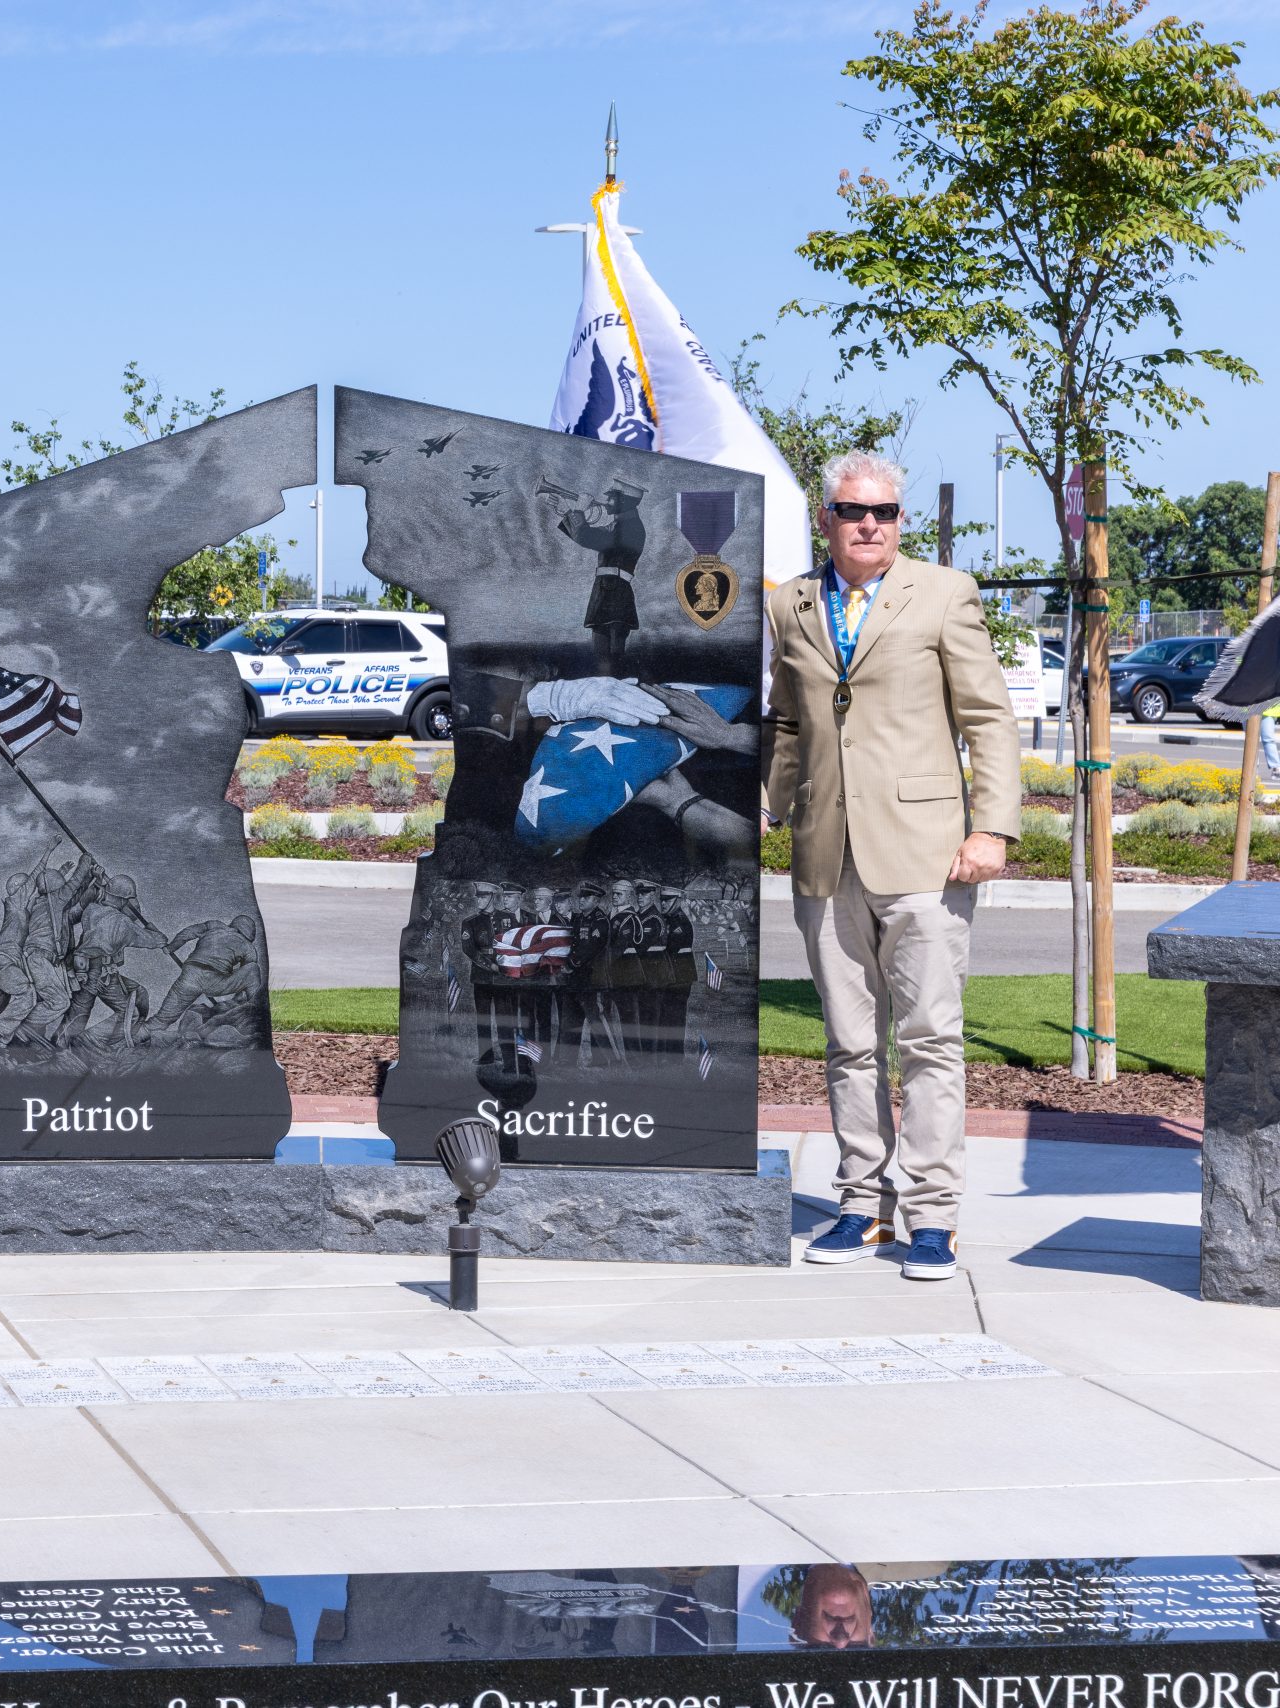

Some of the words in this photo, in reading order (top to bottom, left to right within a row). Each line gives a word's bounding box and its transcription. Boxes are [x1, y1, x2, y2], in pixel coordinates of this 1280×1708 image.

[1066, 486, 1084, 516] STO
[289, 666, 333, 675] VETERANS
[283, 674, 407, 696] POLICE
[282, 697, 292, 706] To
[295, 697, 325, 706] Protect
[328, 696, 349, 705] Those
[352, 695, 370, 703] Who
[373, 694, 402, 703] Served
[22, 1096, 154, 1133] Patriot
[477, 1099, 655, 1139] Sacrifice
[968, 1576, 1076, 1588] Veteran
[1075, 1573, 1232, 1585] Hernandez,
[867, 1580, 966, 1590] USMC
[17, 1588, 104, 1598] Green
[112, 1587, 180, 1595] Gina
[993, 1589, 1081, 1599] USAF
[1081, 1586, 1190, 1596] Veteran
[0, 1599, 102, 1609] Adame
[104, 1597, 190, 1607] Mary
[976, 1600, 1077, 1610] USMC
[1081, 1597, 1189, 1608] Veteran
[0, 1611, 101, 1621] Graves
[109, 1609, 198, 1619] Kevin
[930, 1612, 1032, 1623] USMC
[1033, 1610, 1143, 1621] Veteran
[22, 1623, 120, 1632] Moore
[127, 1621, 207, 1630] Steve
[1122, 1619, 1255, 1629] Anderson
[923, 1624, 1063, 1635] Chairman
[129, 1632, 217, 1642] Linda
[10, 1647, 147, 1657] Conover,
[154, 1644, 224, 1655] Julia
[848, 1676, 938, 1708] Will
[953, 1674, 1125, 1708] NEVER
